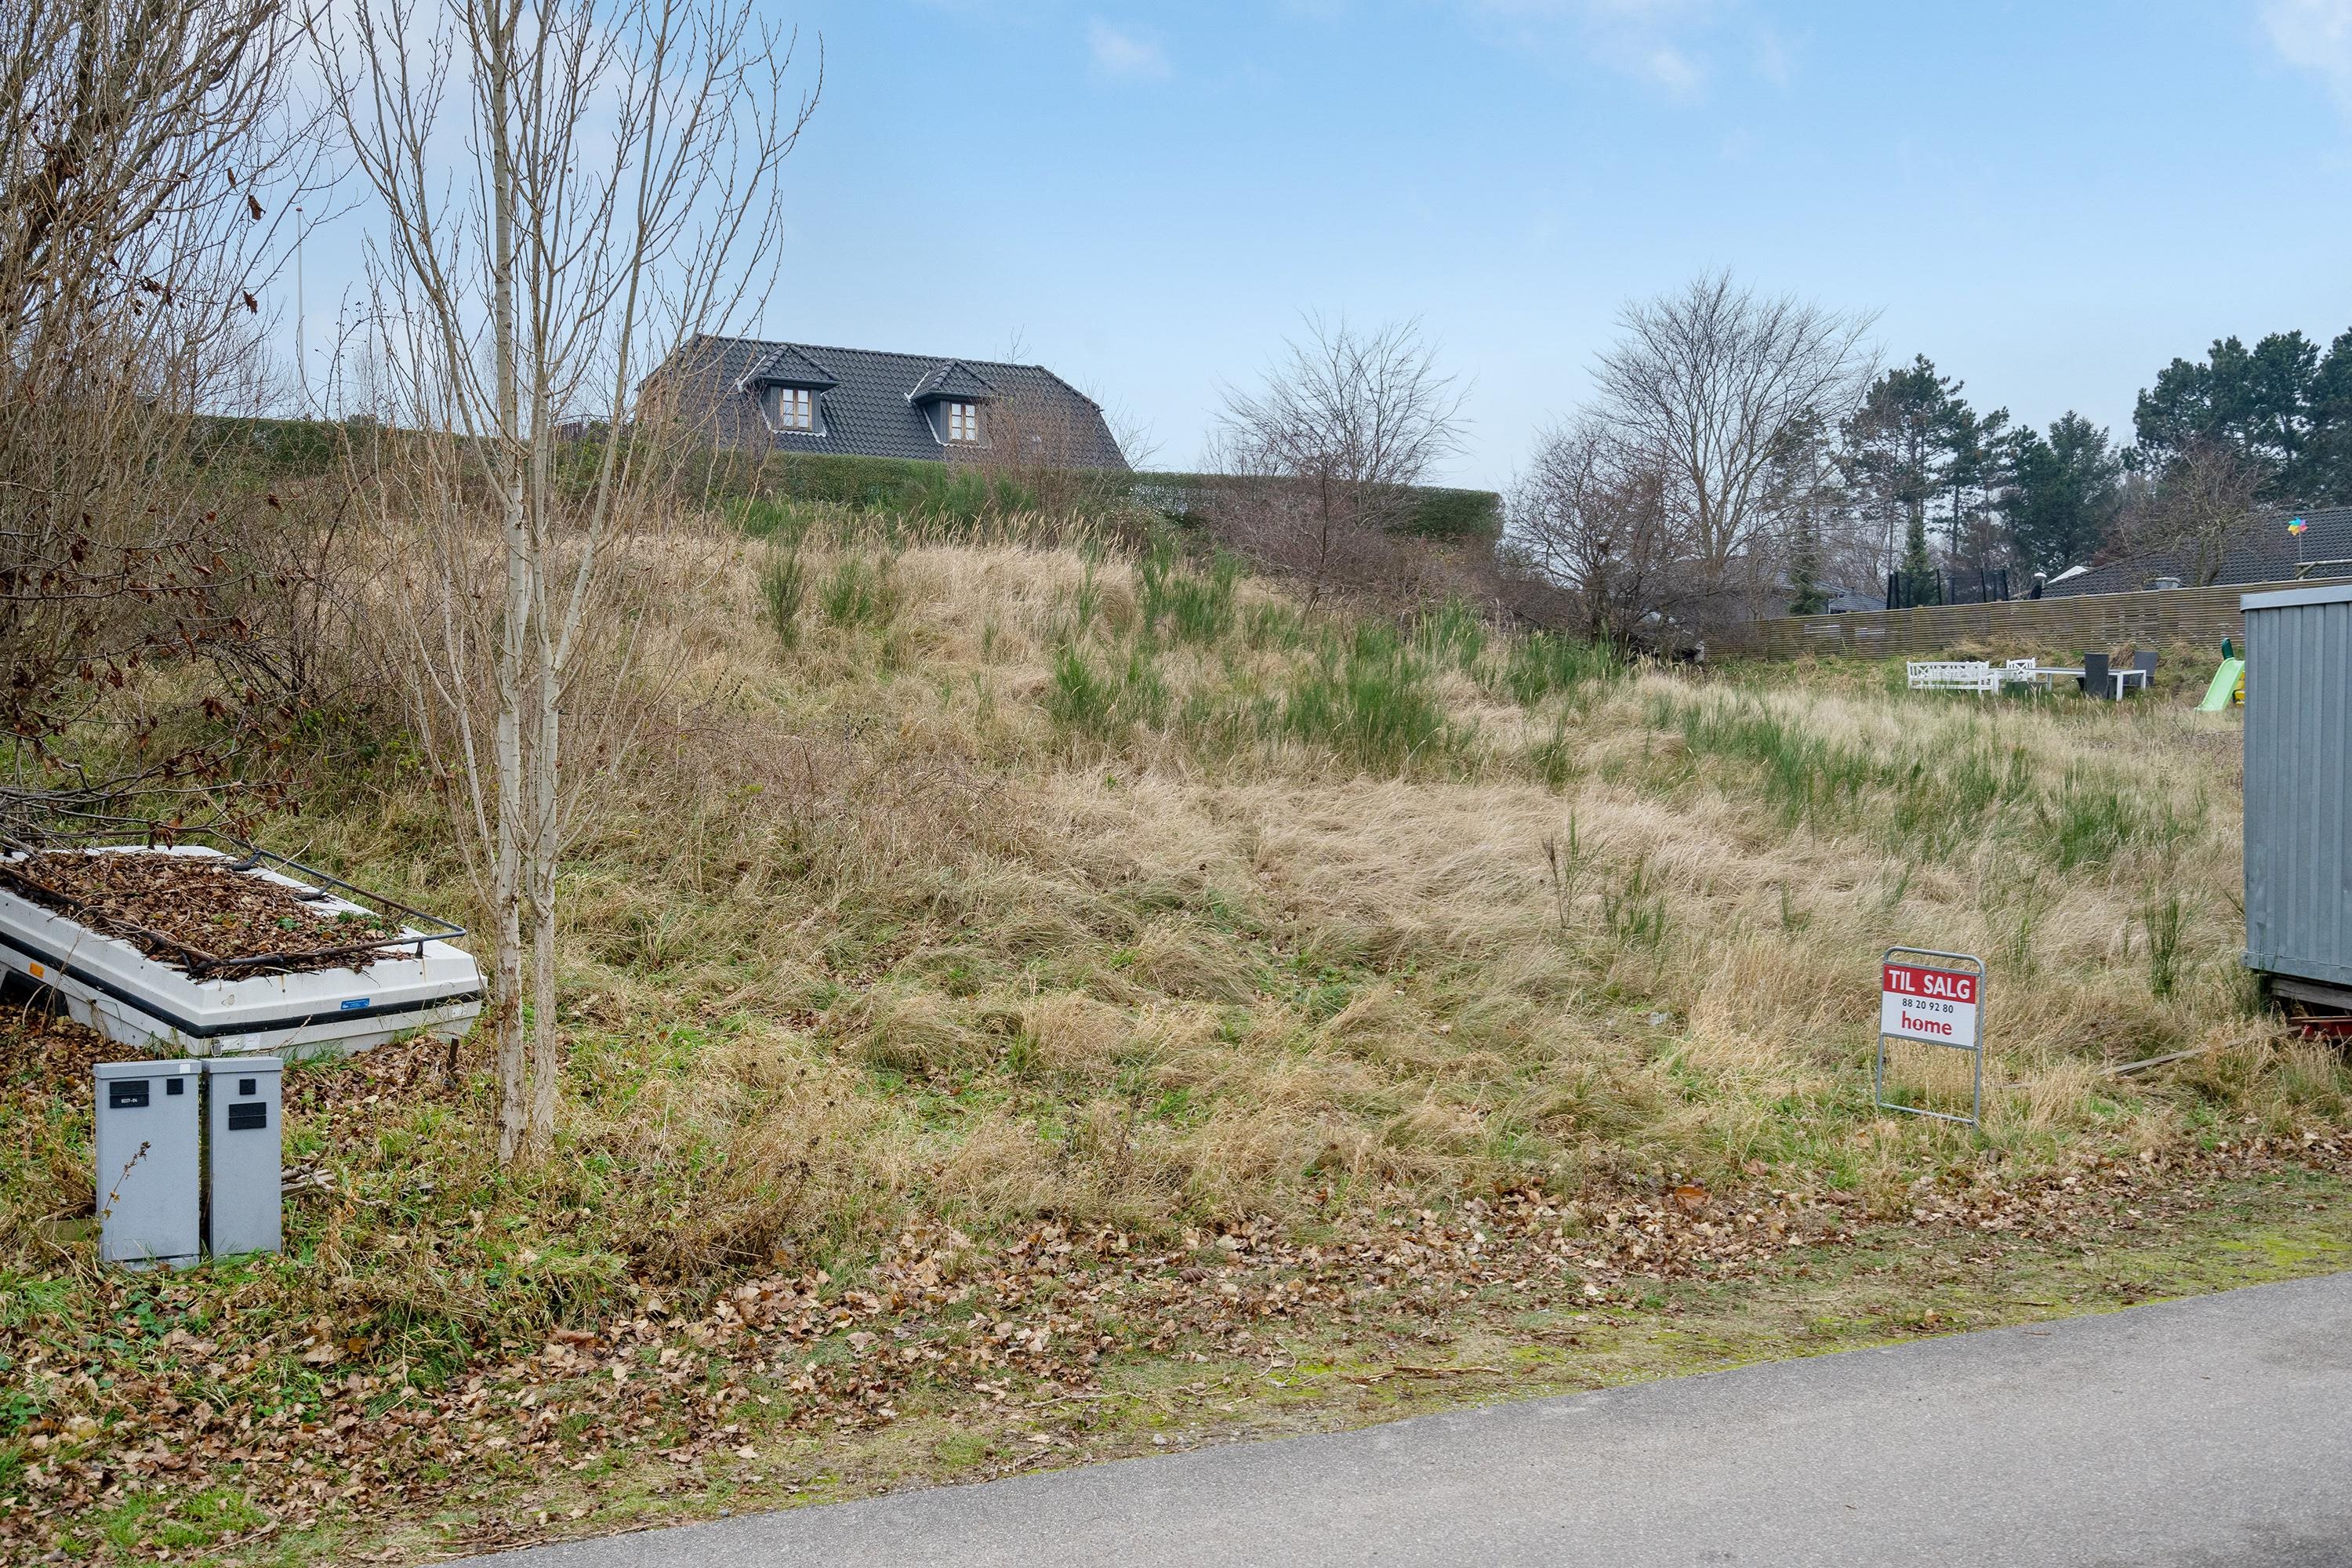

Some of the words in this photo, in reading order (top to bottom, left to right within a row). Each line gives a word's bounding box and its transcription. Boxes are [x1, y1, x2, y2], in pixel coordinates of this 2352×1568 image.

[1889, 969, 1915, 992] TIL
[1923, 975, 1970, 999] SALG
[1902, 998, 1913, 1007] 88
[1916, 1000, 1926, 1009] 20
[1929, 1002, 1940, 1011] 92
[1943, 1004, 1954, 1013] 80
[1901, 1011, 1952, 1036] home
